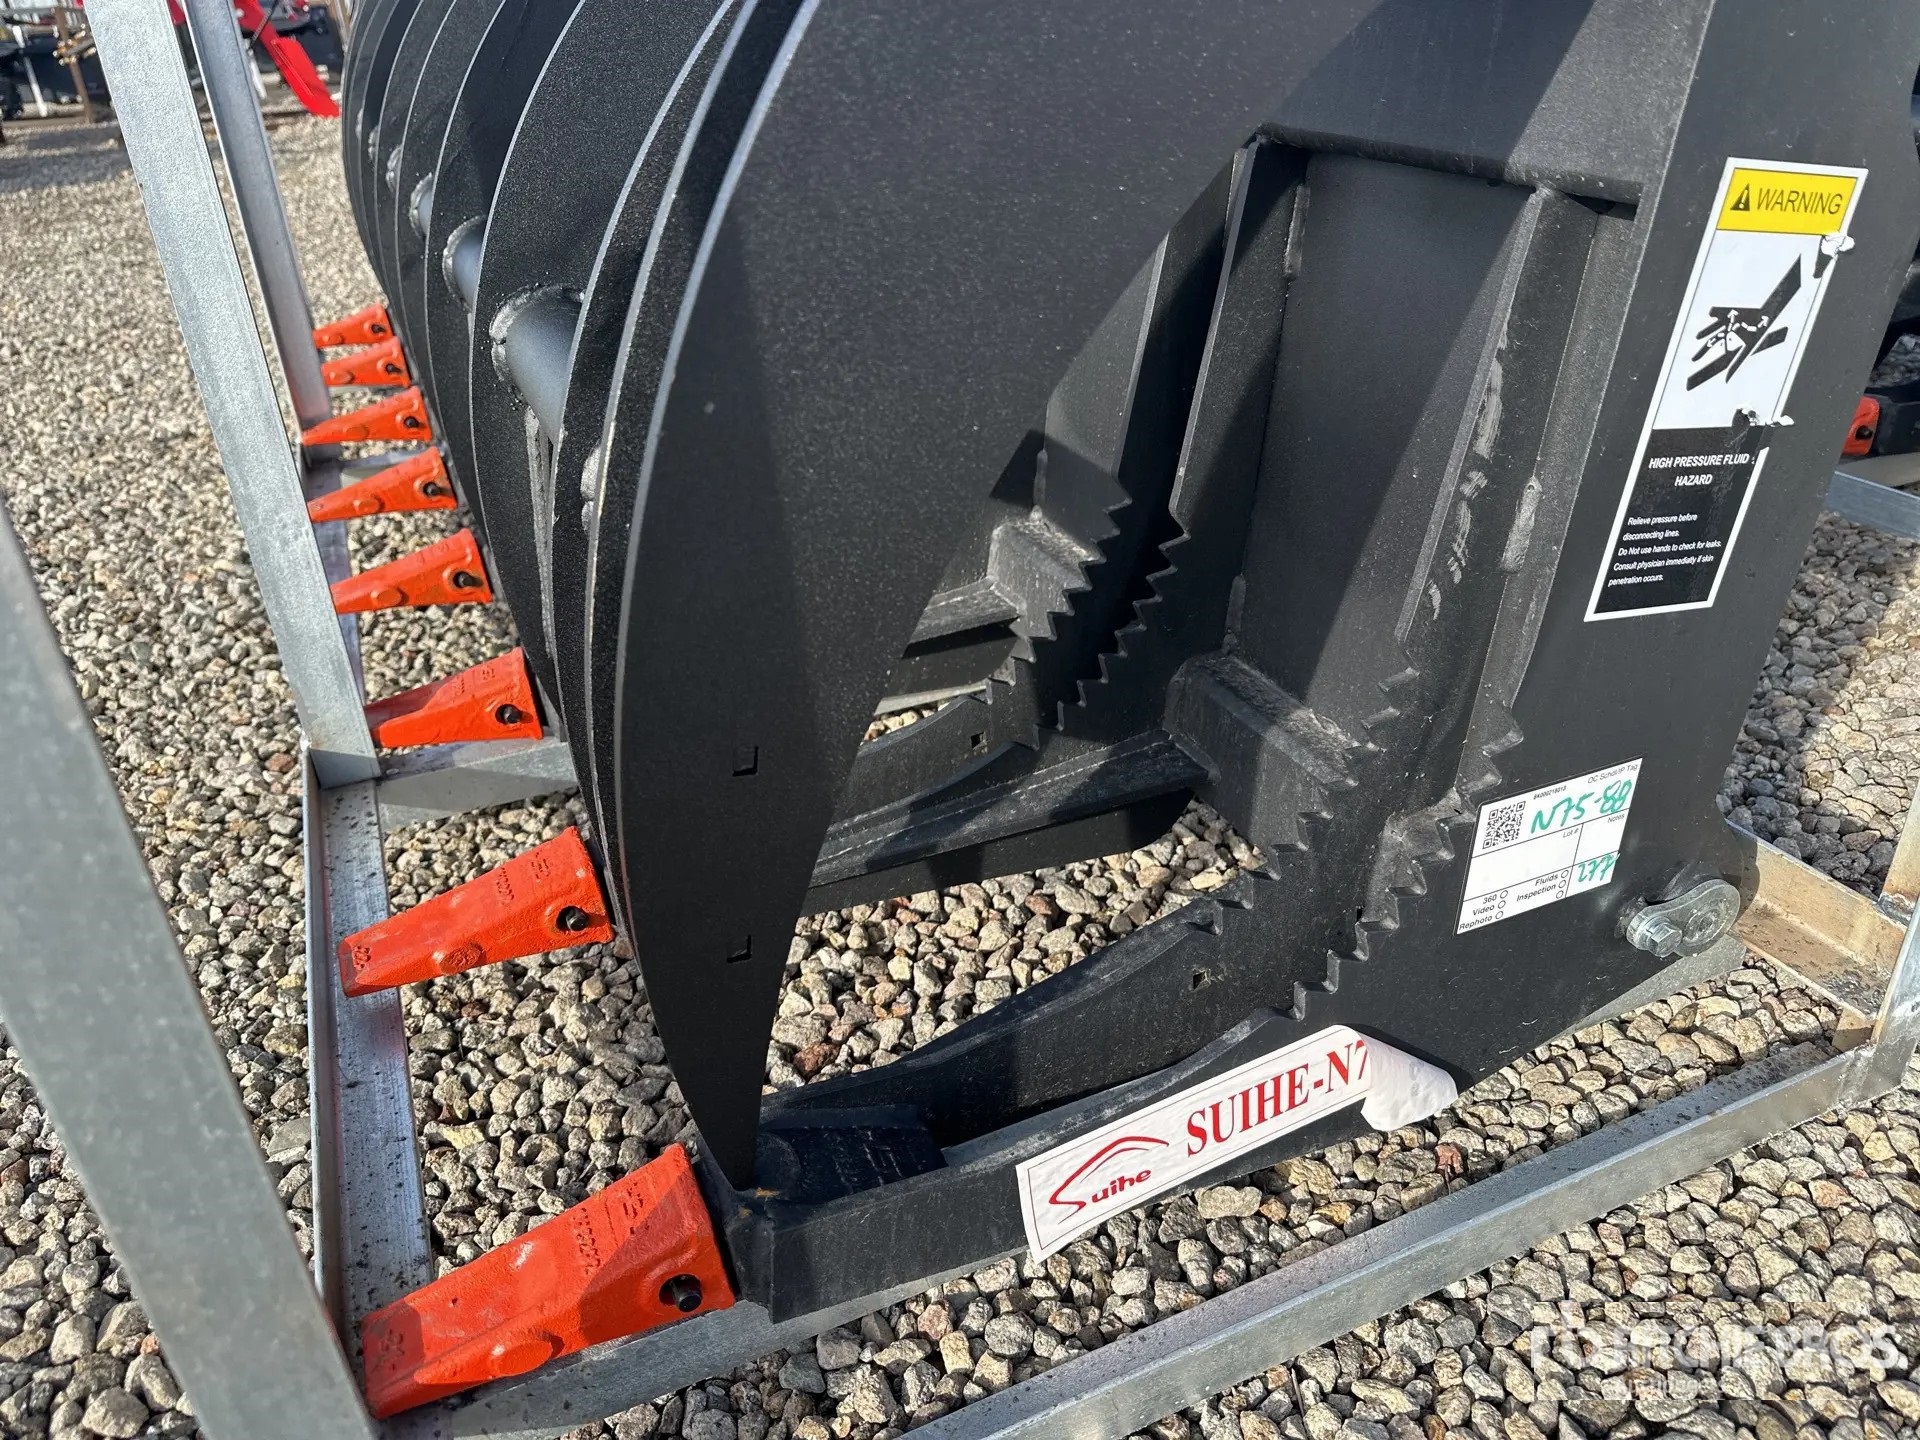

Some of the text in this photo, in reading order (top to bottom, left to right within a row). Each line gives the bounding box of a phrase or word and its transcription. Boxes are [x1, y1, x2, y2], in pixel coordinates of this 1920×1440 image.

[1756, 187, 1843, 215] WARNING
[1648, 453, 1750, 469] HIGH PRESSURE FLUID
[1674, 473, 1713, 487] HAZARD
[1628, 512, 1698, 526] Relieve pressure before
[1622, 530, 1664, 541] disconnecting
[1617, 547, 1628, 556] Do
[1628, 545, 1640, 555] Not
[1640, 546, 1652, 554] use
[1652, 543, 1671, 553] hands
[1671, 543, 1679, 552] to
[1678, 541, 1696, 551] check
[1696, 540, 1706, 549] for
[1613, 561, 1637, 572] Consult
[1636, 559, 1666, 571] physician
[1701, 553, 1714, 563] skin
[1607, 574, 1645, 588] penetration
[1607, 813, 1625, 823] Notes
[1562, 829, 1574, 838] Lot
[1535, 874, 1559, 887] Fluids
[1482, 894, 1498, 905] 360
[1516, 883, 1557, 902] Inspection
[1472, 904, 1496, 916] Video
[1458, 915, 1493, 931] Rephoto
